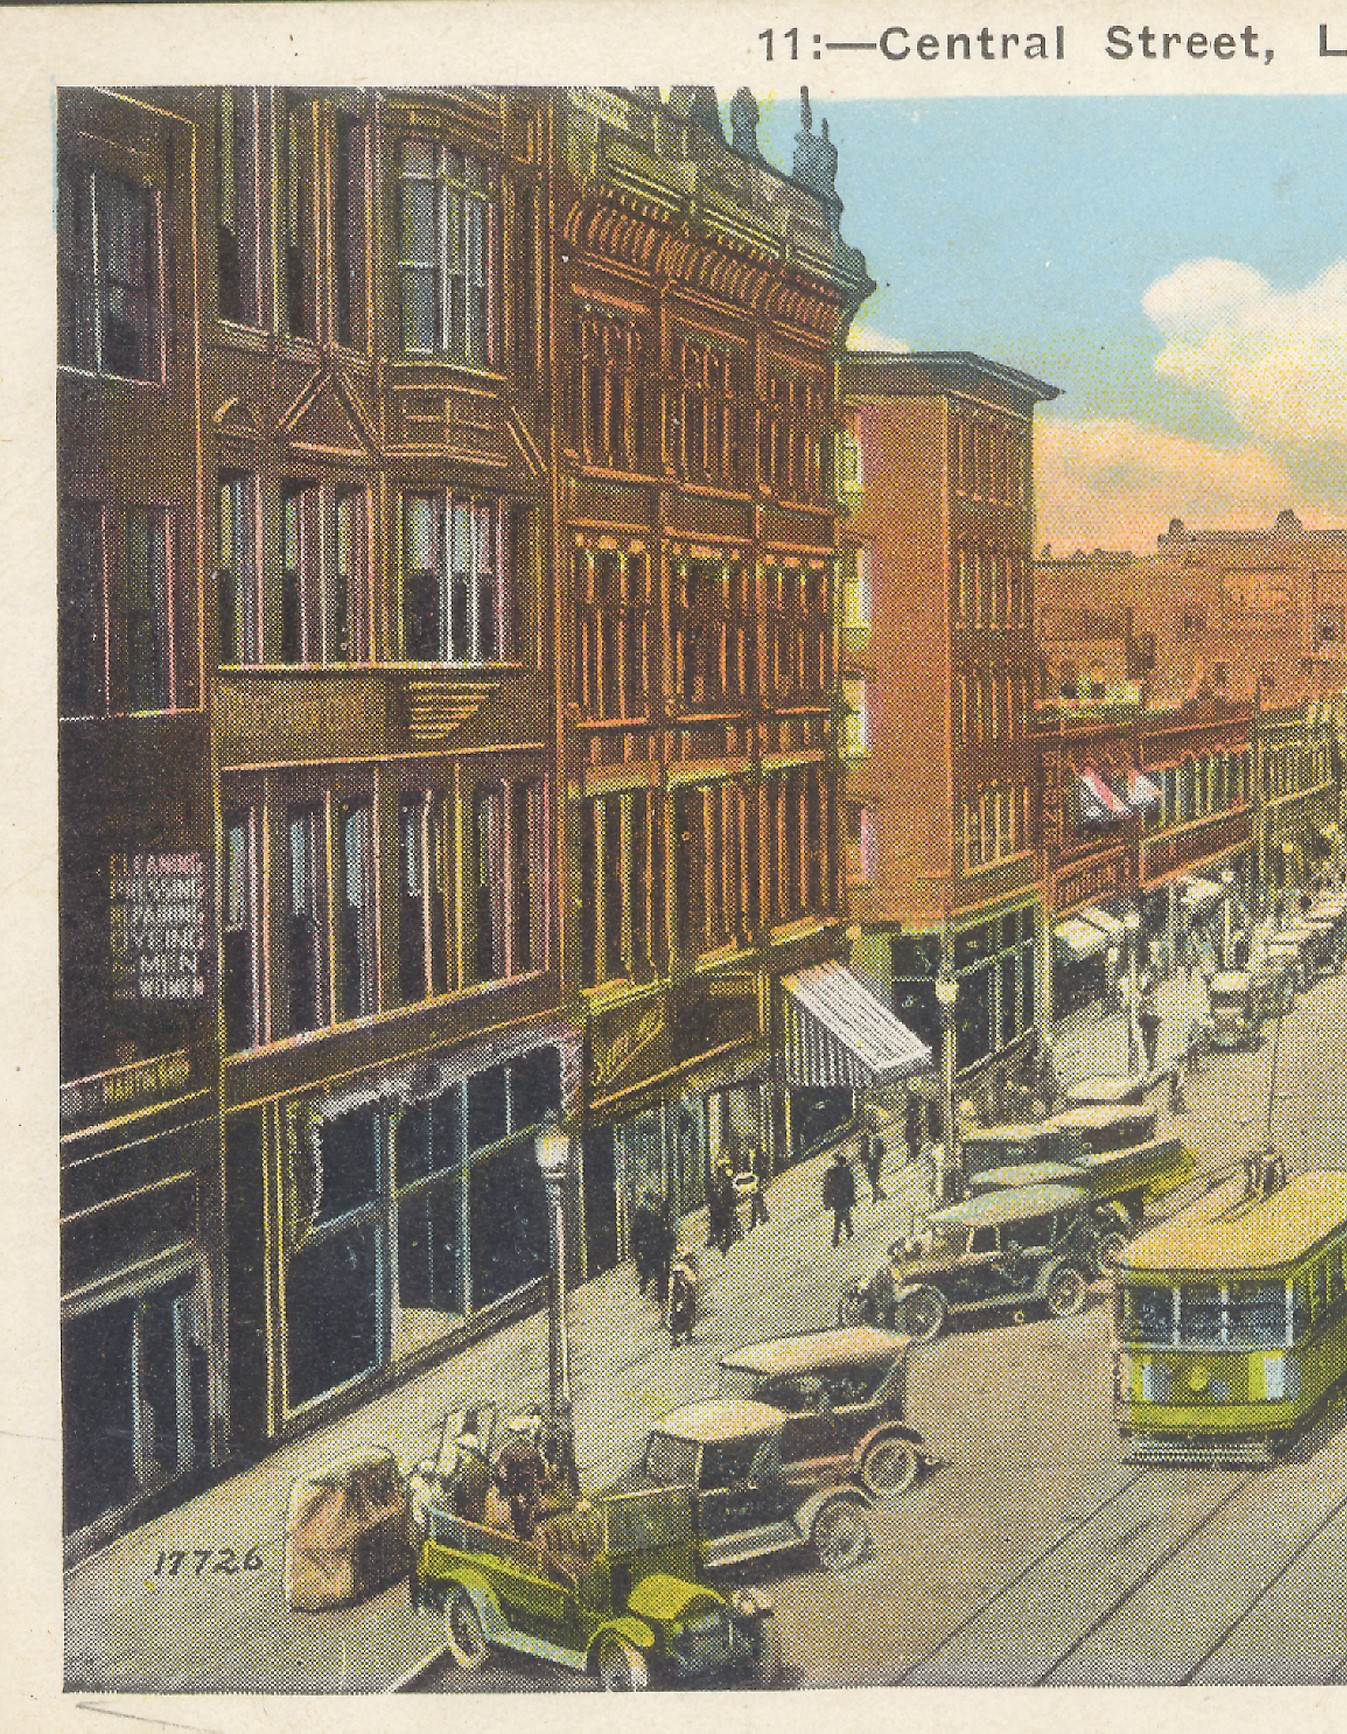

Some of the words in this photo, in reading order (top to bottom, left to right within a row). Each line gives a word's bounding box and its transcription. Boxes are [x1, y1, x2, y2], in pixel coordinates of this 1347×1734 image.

[109, 853, 205, 875] CLEANING
[109, 878, 205, 900] PRESSING
[139, 953, 199, 974] MEN
[138, 976, 205, 998] WOMEN
